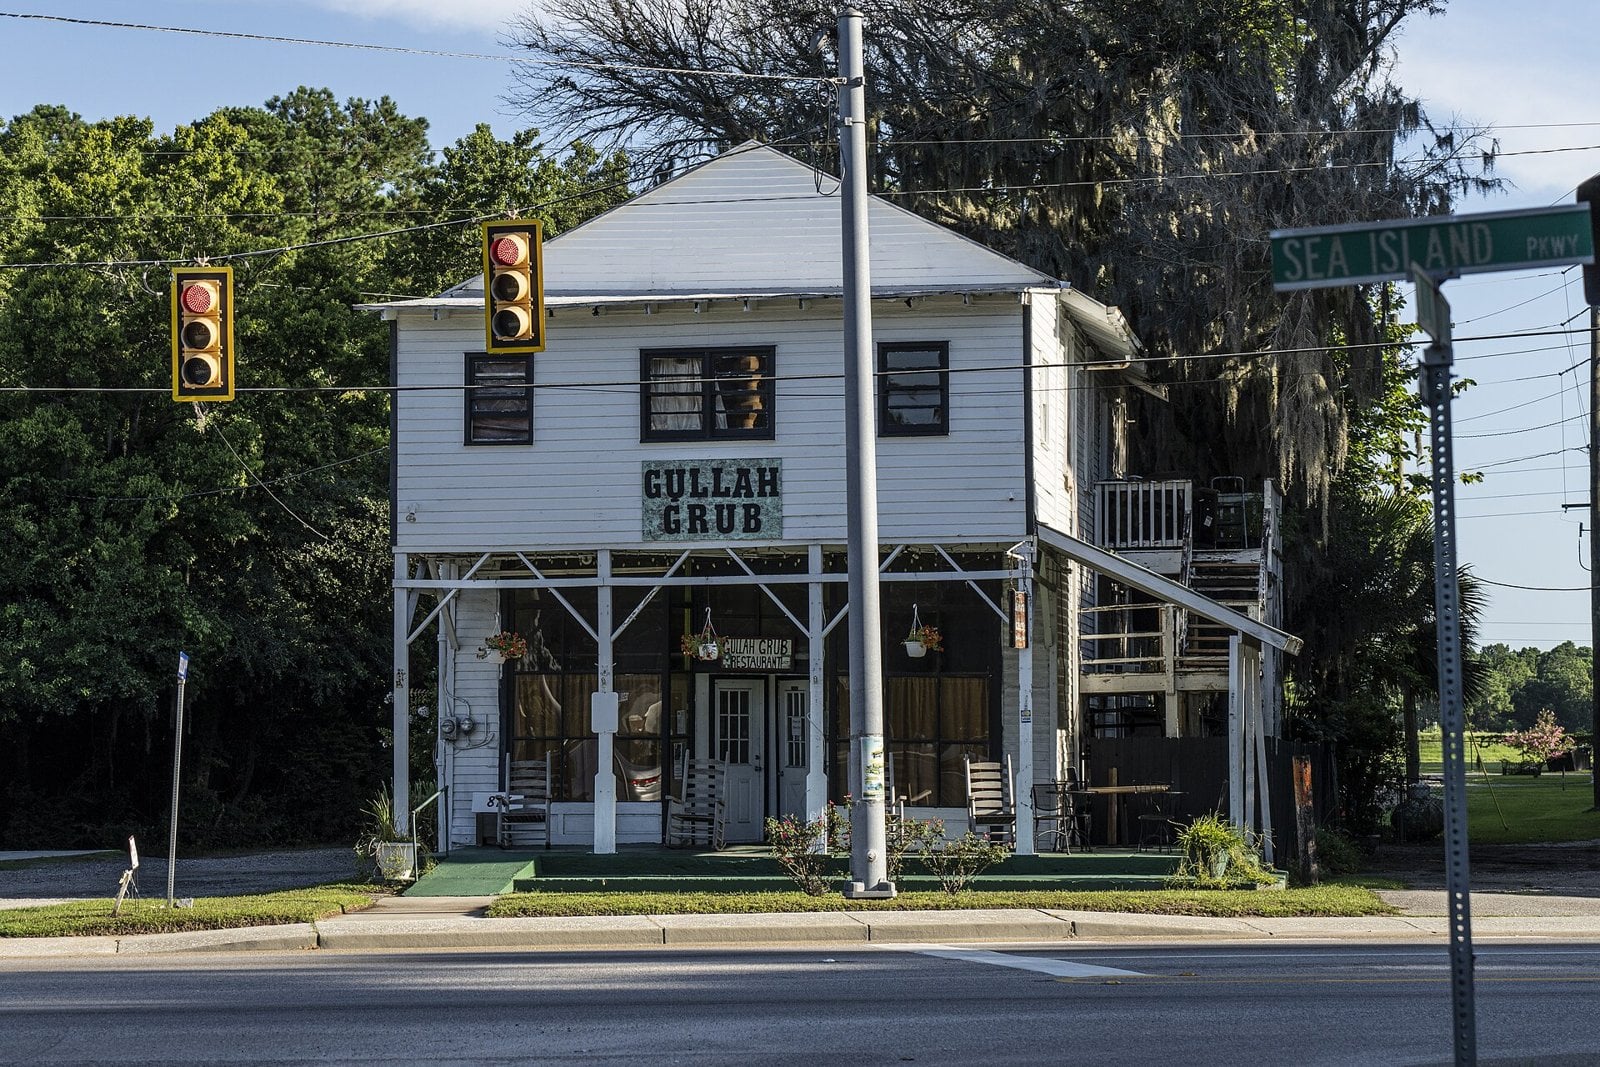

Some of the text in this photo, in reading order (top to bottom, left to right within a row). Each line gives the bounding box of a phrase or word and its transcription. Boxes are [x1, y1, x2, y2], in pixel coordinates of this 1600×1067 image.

[1282, 223, 1579, 281] SEA ISLAND PKWY
[644, 467, 779, 499] GULLAH
[663, 503, 762, 535] GRUB
[723, 639, 788, 655] GULLAH GRUB
[731, 655, 783, 669] RESTAURANT
